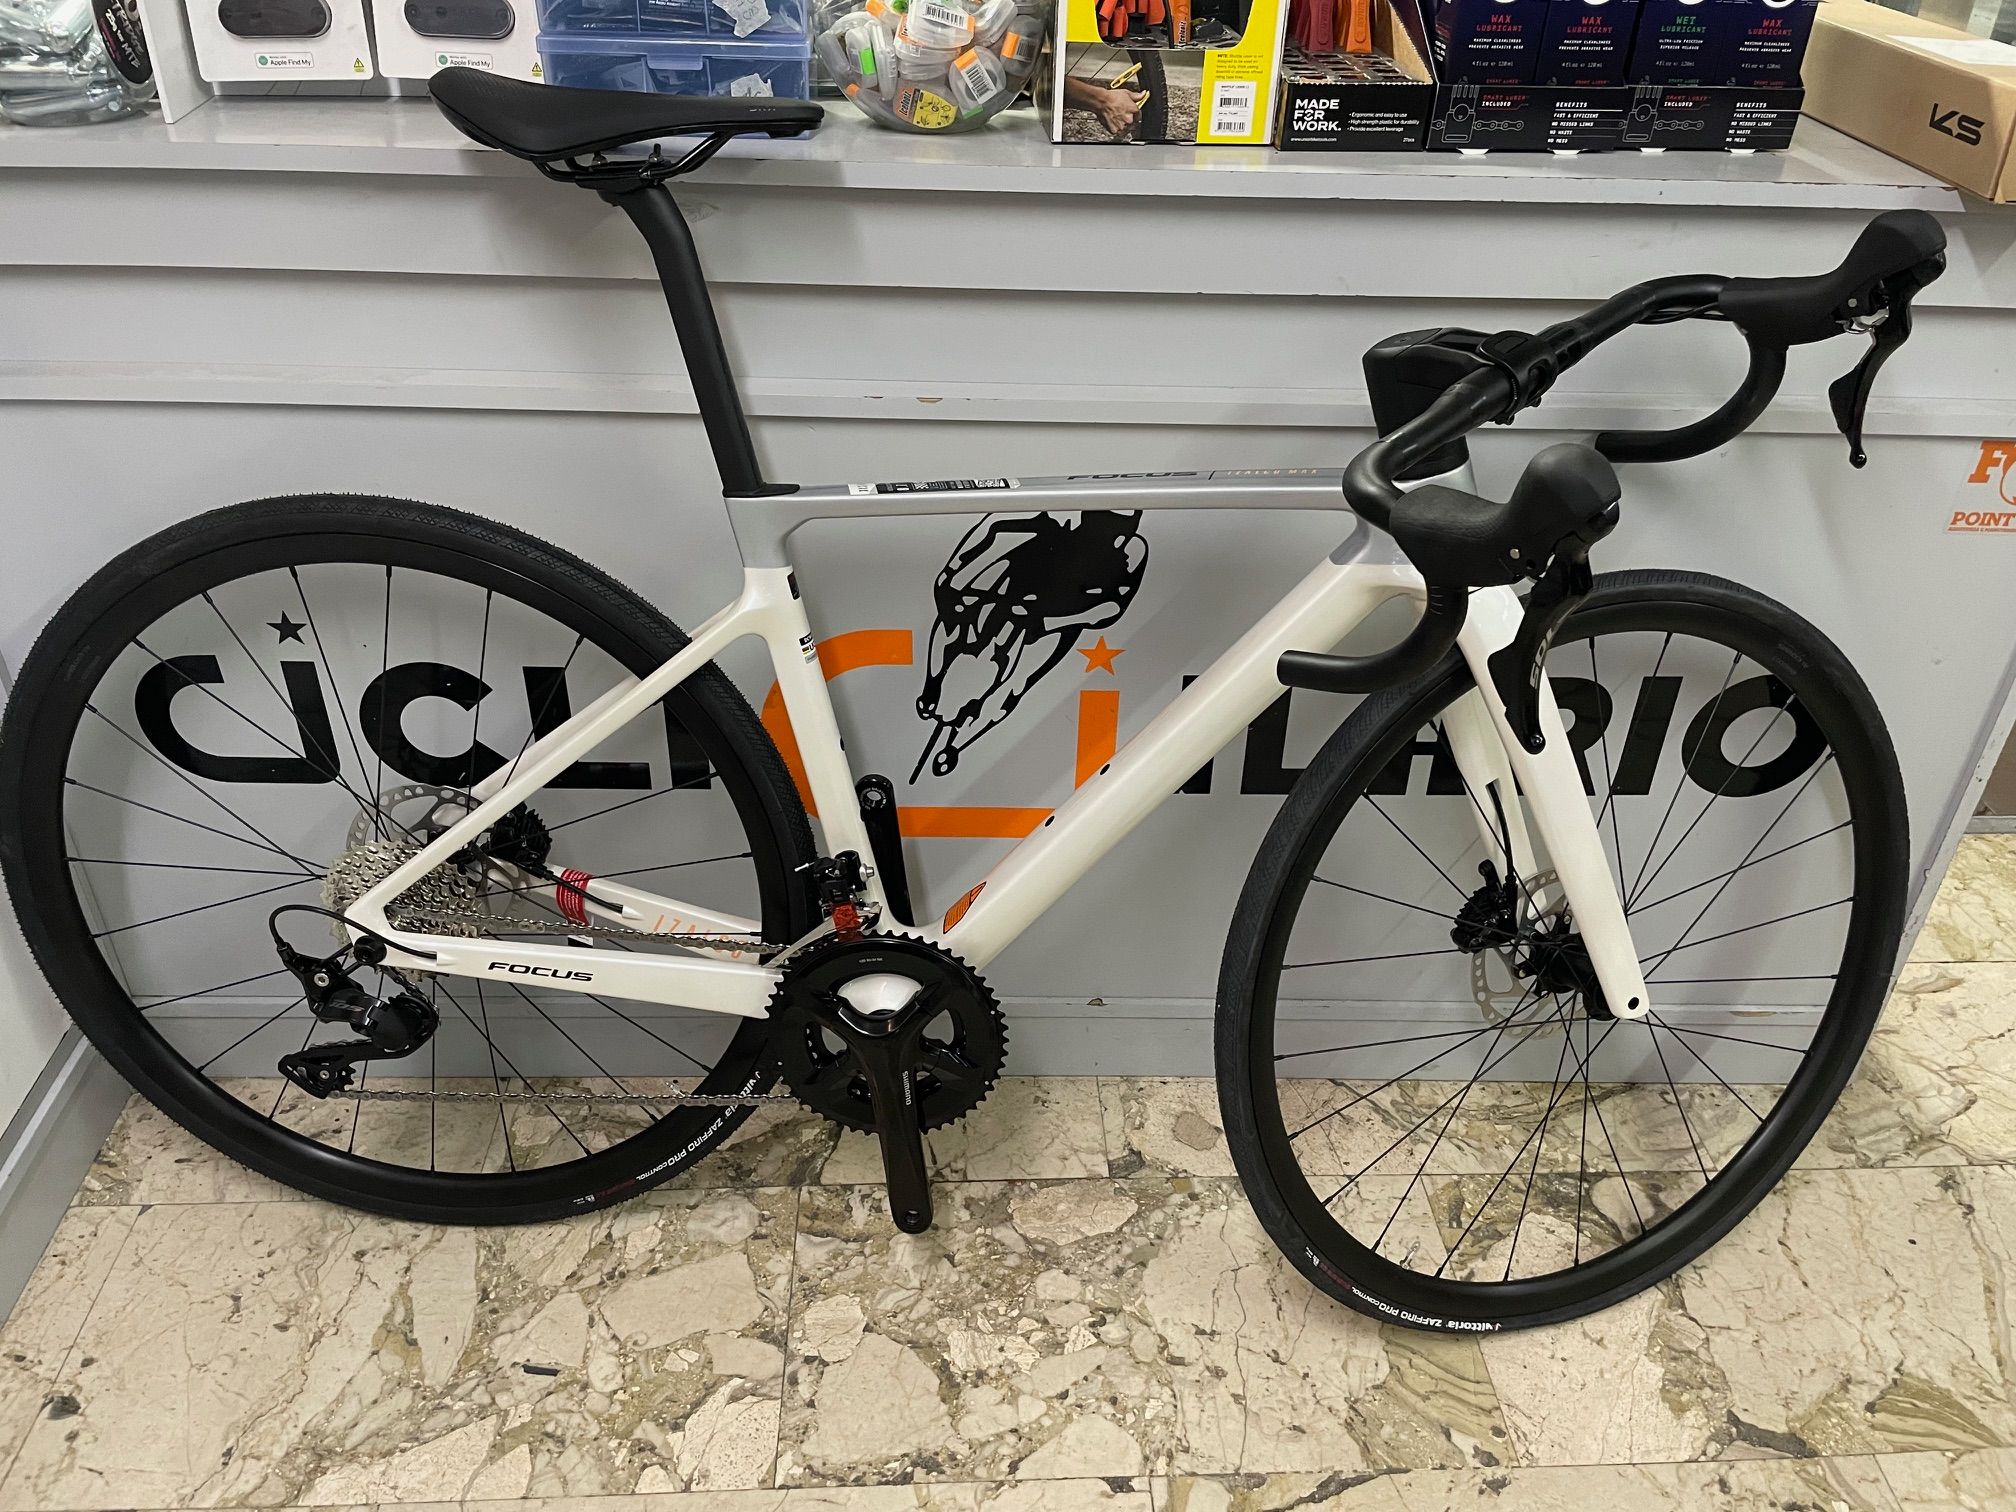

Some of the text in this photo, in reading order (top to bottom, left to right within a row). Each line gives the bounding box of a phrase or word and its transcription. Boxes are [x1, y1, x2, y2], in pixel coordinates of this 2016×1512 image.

[1491, 14, 1512, 24] WAX
[1582, 16, 1602, 25] WAX
[1676, 16, 1696, 24] WET
[1762, 18, 1783, 28] WAX
[1567, 26, 1613, 34] LUBRICANT
[270, 59, 287, 67] Apple
[302, 59, 311, 67] My
[1295, 98, 1340, 110] MADE
[1294, 109, 1325, 121] FOR
[1292, 121, 1342, 131] WORK.
[1929, 103, 1985, 146] KS
[1067, 470, 1198, 481] FOCUS
[1949, 511, 2016, 527] POINT
[487, 961, 594, 983] FOCUS
[687, 1118, 724, 1153] ZAFFIRO
[1400, 1309, 1442, 1328] ZAFFIRO
